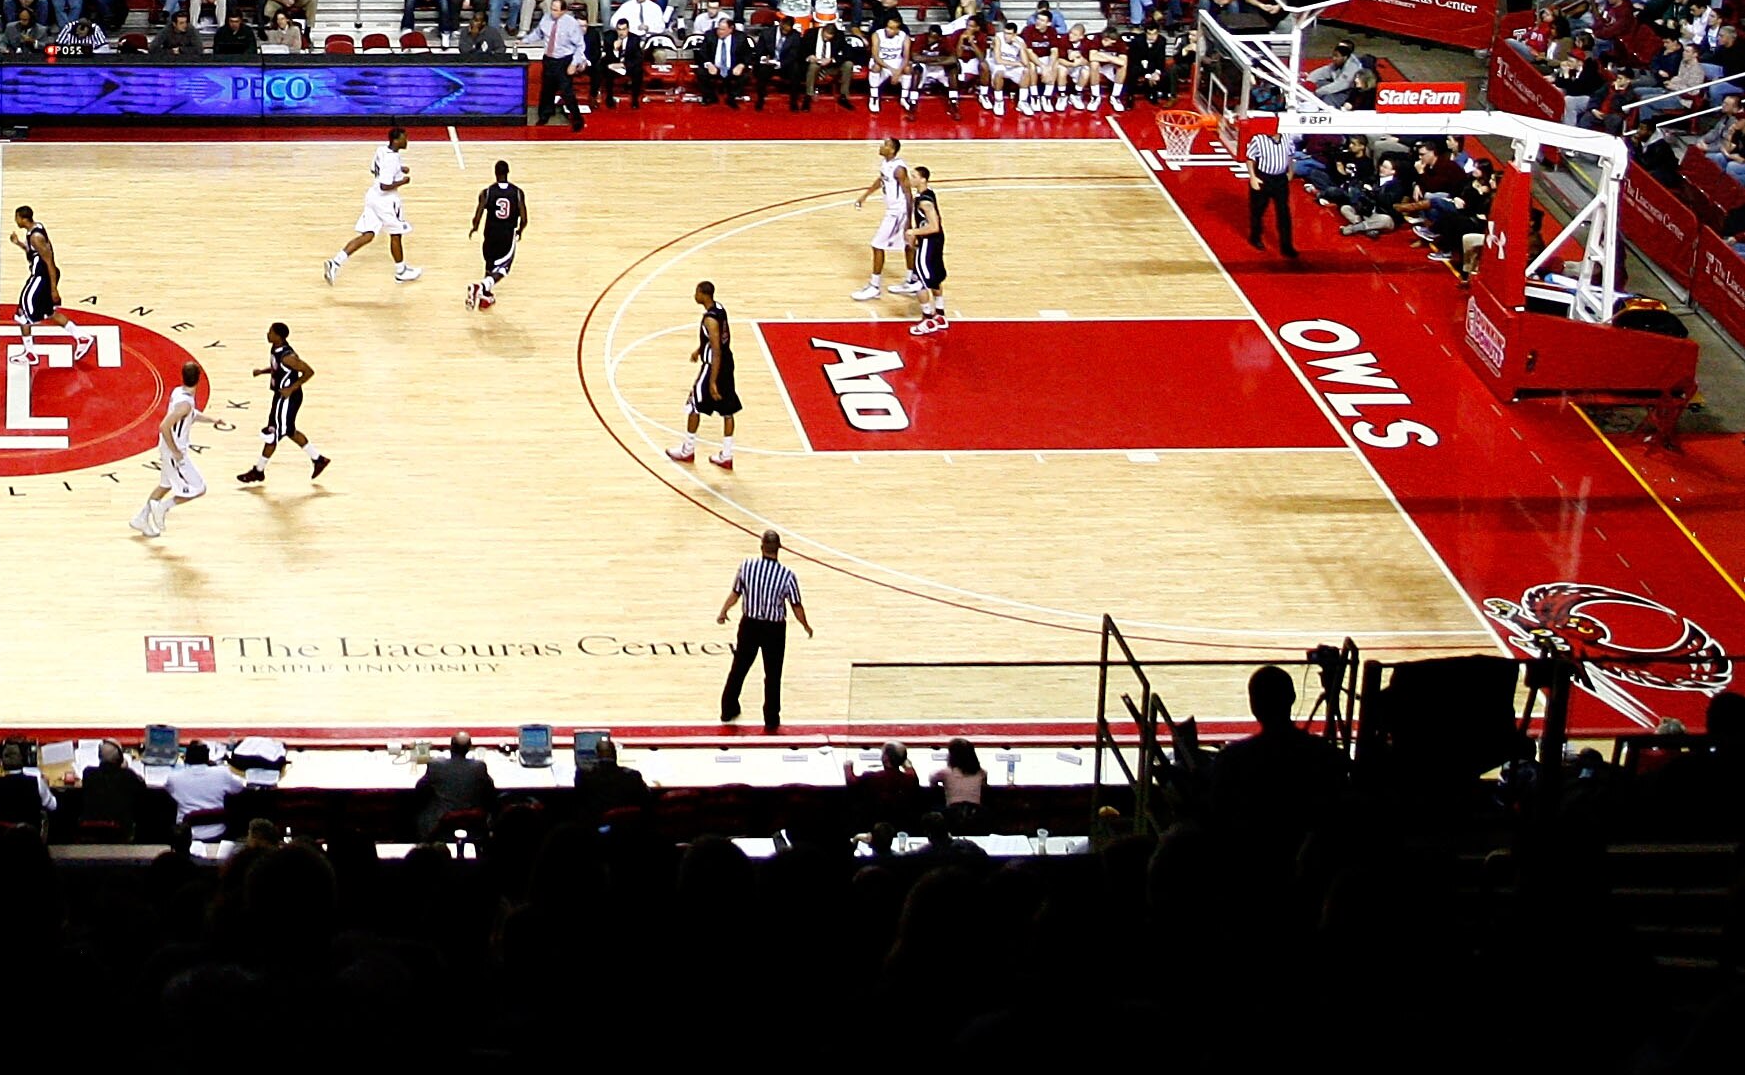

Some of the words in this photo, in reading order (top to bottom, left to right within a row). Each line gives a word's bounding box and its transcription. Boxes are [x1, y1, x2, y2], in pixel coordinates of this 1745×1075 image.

[232, 76, 313, 102] PECO
[495, 198, 511, 219] 3
[811, 336, 911, 433] A10
[1278, 318, 1440, 450] OWLS
[222, 635, 322, 658] The
[336, 635, 562, 658] Liacouras
